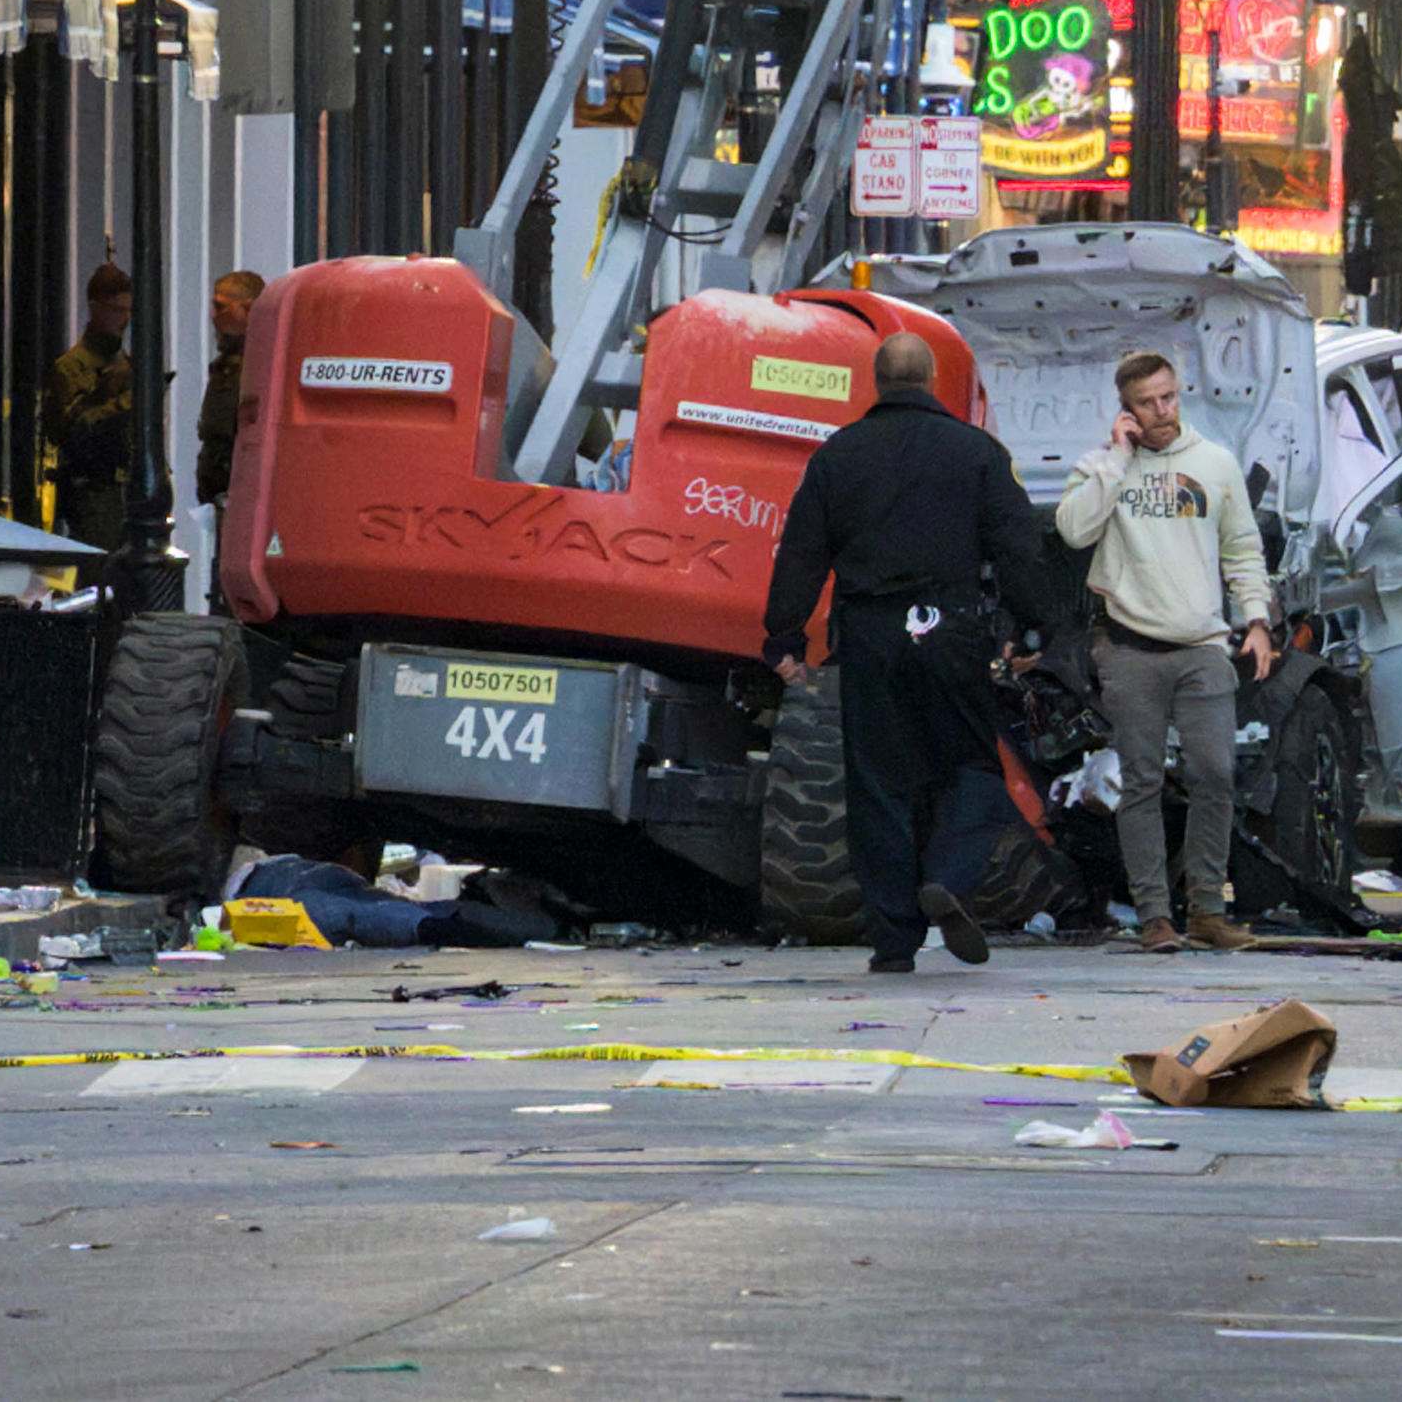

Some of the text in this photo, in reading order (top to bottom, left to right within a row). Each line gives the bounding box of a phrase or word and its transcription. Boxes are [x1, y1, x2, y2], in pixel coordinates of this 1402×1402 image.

[869, 153, 896, 169] CAB
[943, 152, 957, 165] TO
[1019, 149, 1061, 167] WITH
[925, 167, 974, 179] CORNER
[862, 175, 905, 191] STAND
[924, 197, 975, 210] ANYTIME
[304, 362, 447, 386] 1-800-UR-RENTS
[754, 361, 848, 393] 10507501
[1131, 502, 1175, 518] FACE
[449, 670, 554, 695] 10507501
[445, 705, 547, 764] 4X4
